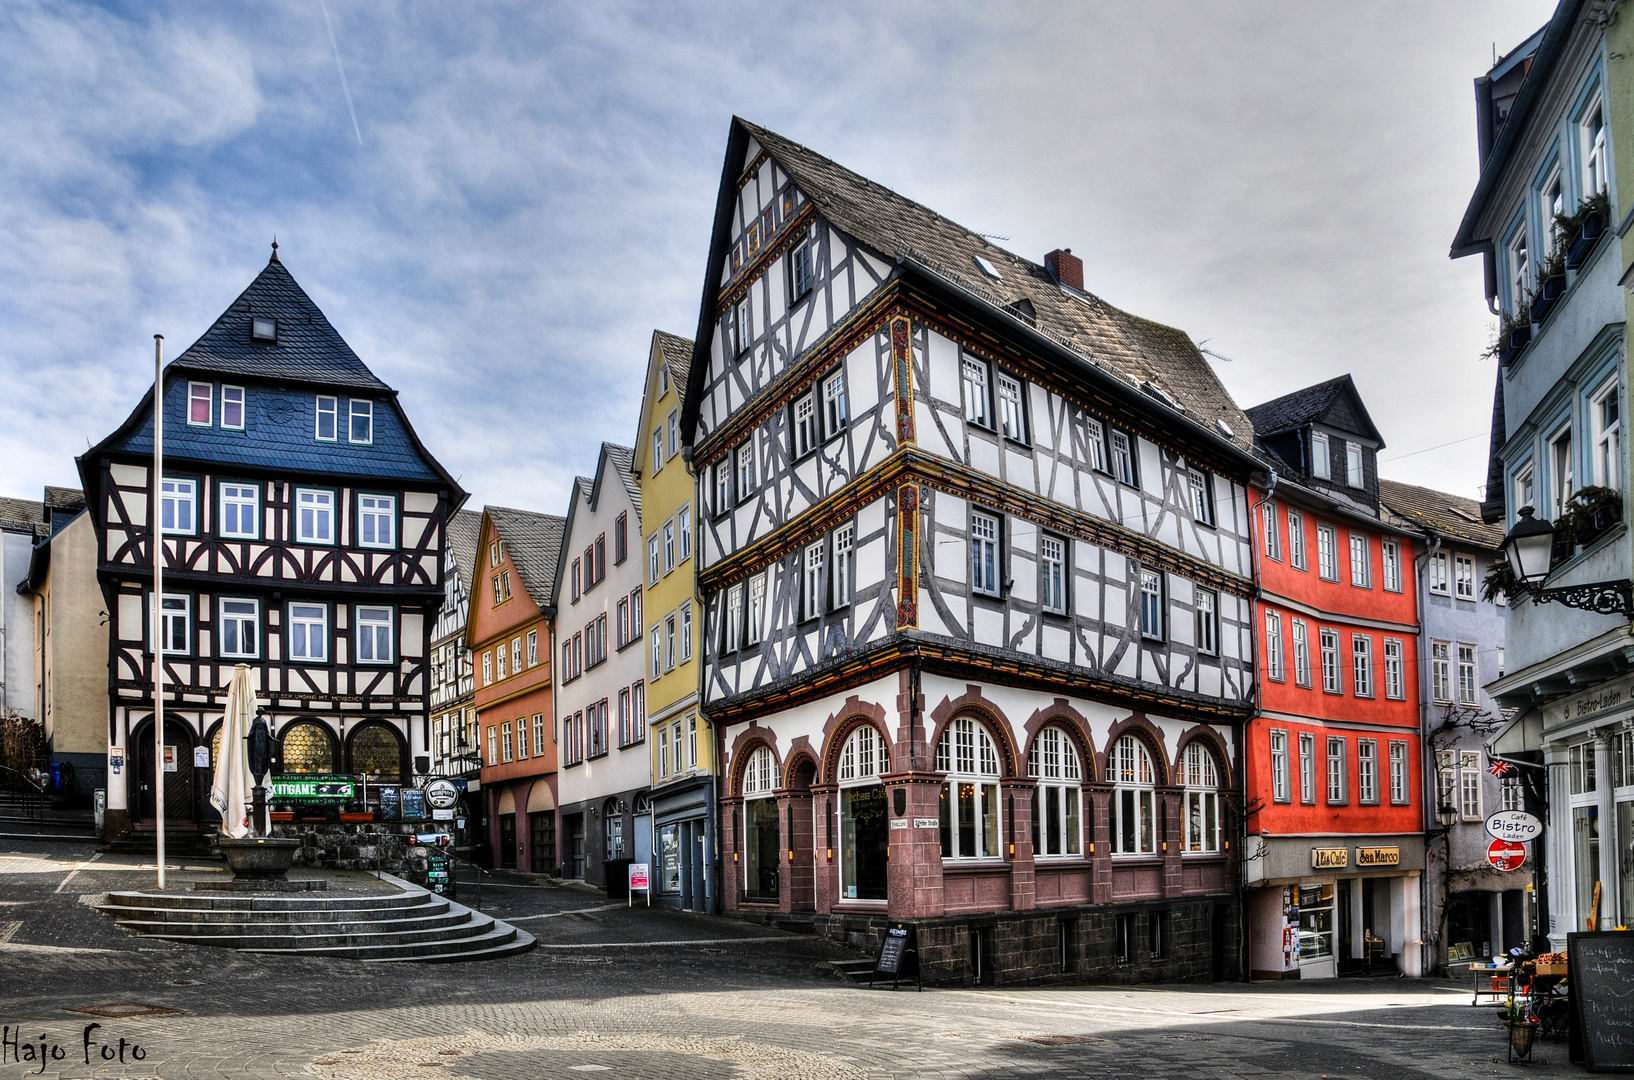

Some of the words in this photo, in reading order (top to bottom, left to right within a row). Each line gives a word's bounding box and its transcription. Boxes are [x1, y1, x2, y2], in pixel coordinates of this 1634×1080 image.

[1577, 689, 1621, 716] Bistro-Laden
[272, 783, 317, 796] XITGAME
[1511, 813, 1528, 821] Café
[1492, 819, 1536, 833] Bistro
[1320, 851, 1330, 866] Eis
[1359, 849, 1374, 864] San
[1374, 850, 1399, 863] Marco
